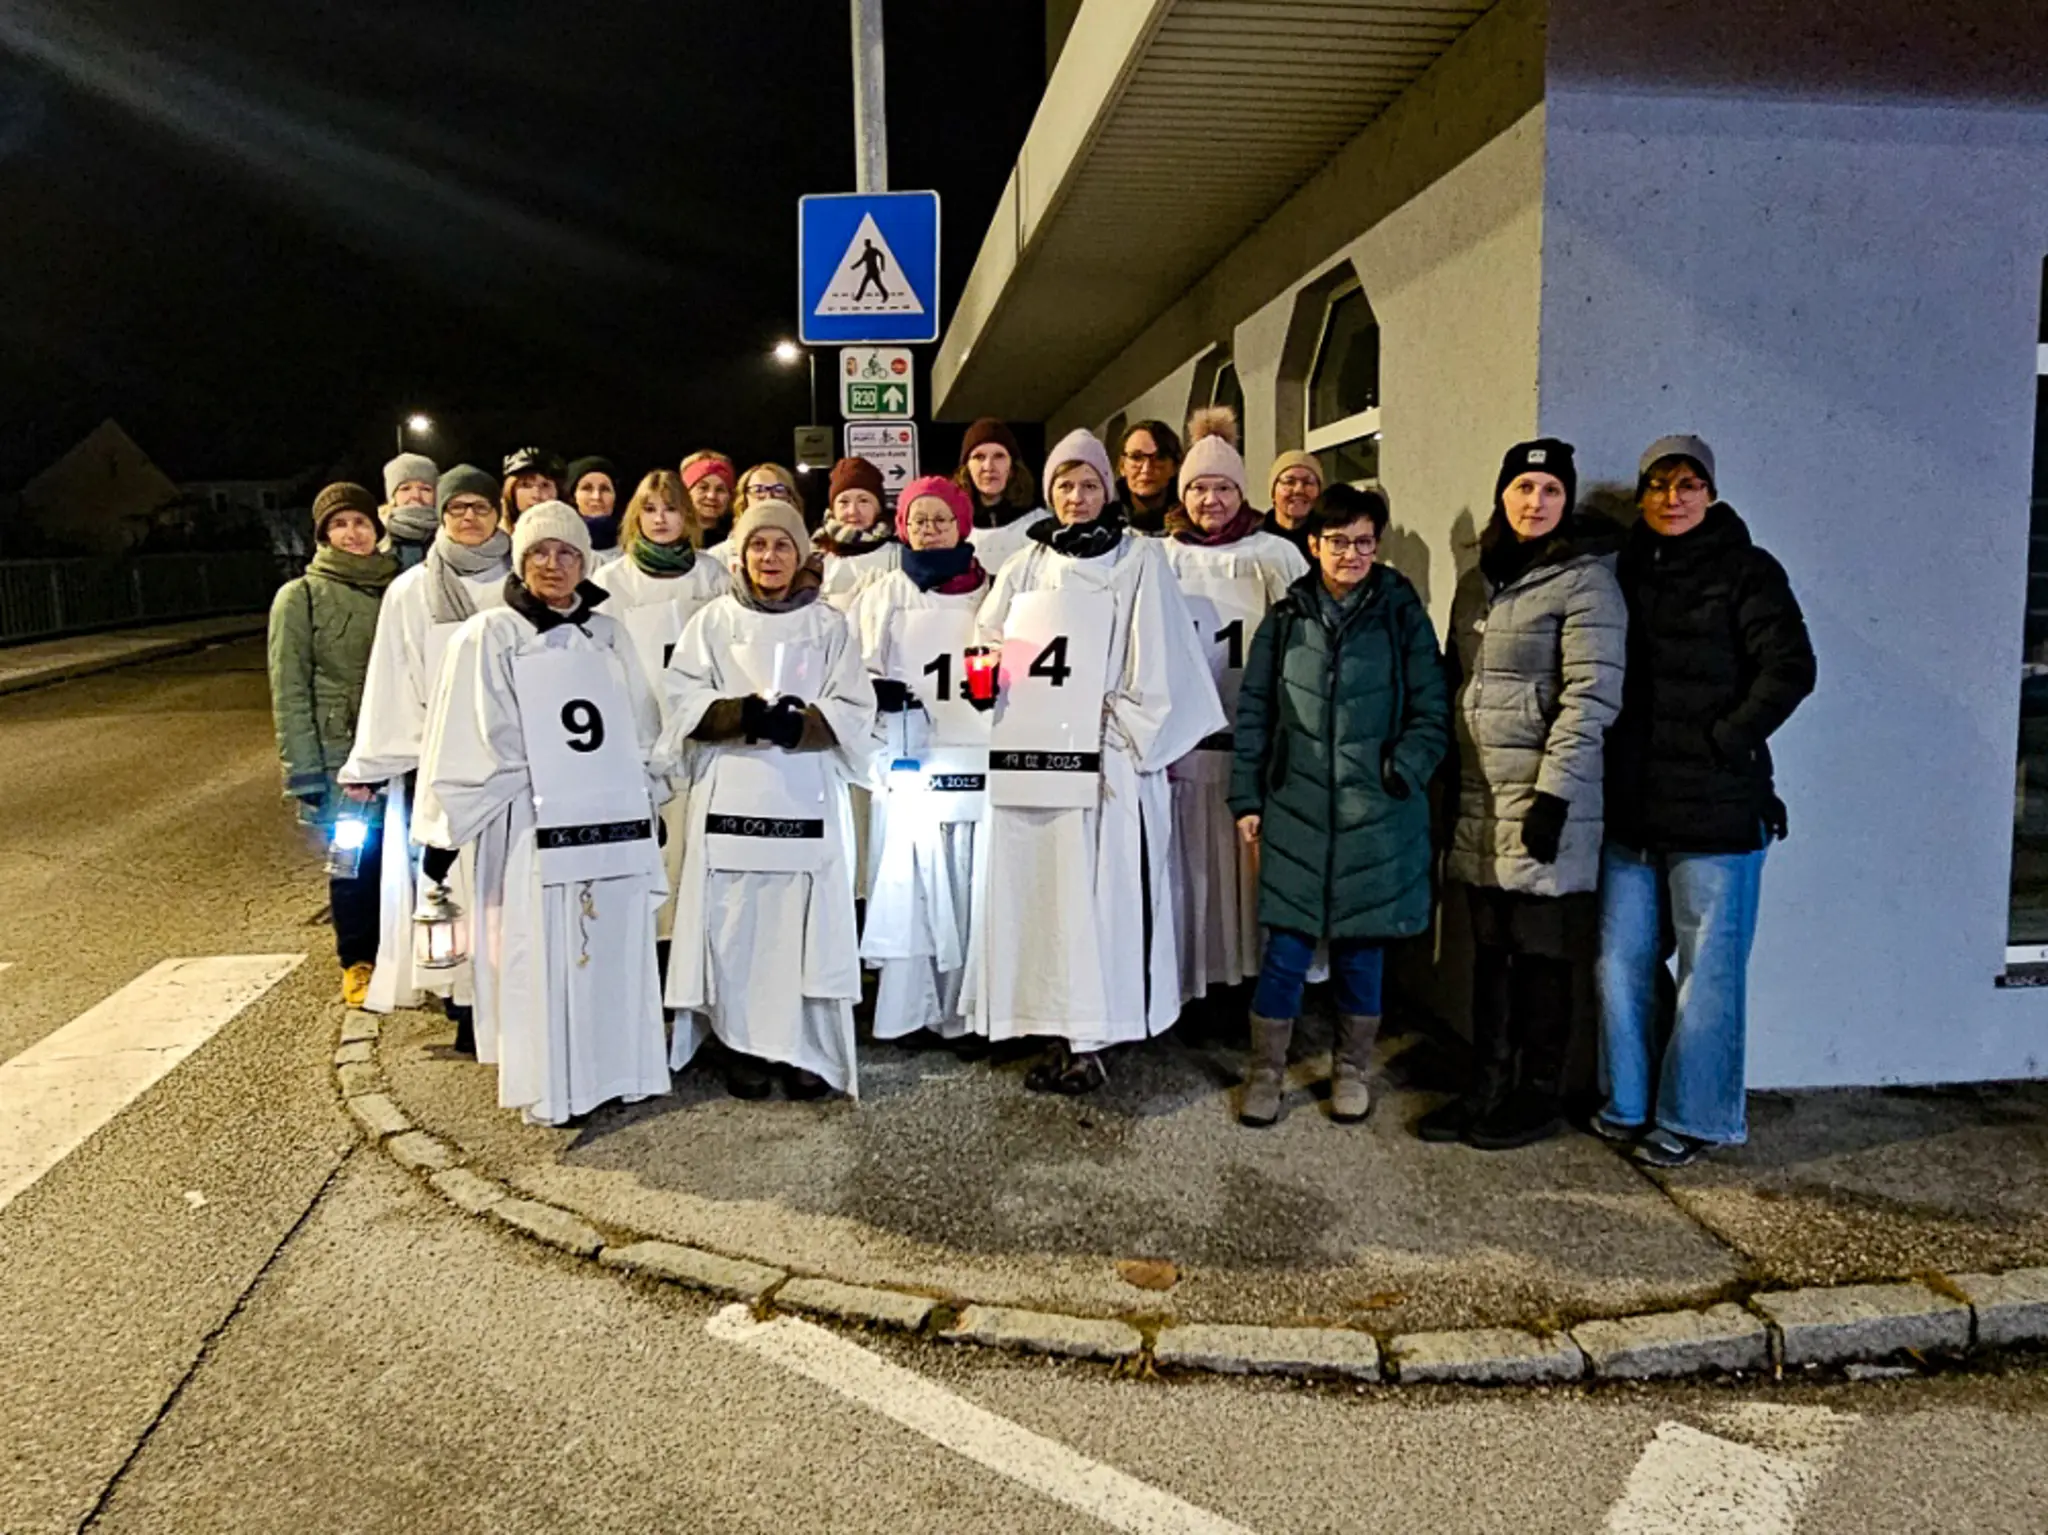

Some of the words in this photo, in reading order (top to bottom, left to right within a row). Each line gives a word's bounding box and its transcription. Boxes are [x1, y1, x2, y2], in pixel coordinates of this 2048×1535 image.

[1028, 636, 1071, 686] 4
[560, 699, 605, 752] 9
[1045, 754, 1082, 769] 2025
[768, 821, 804, 837] 2025
